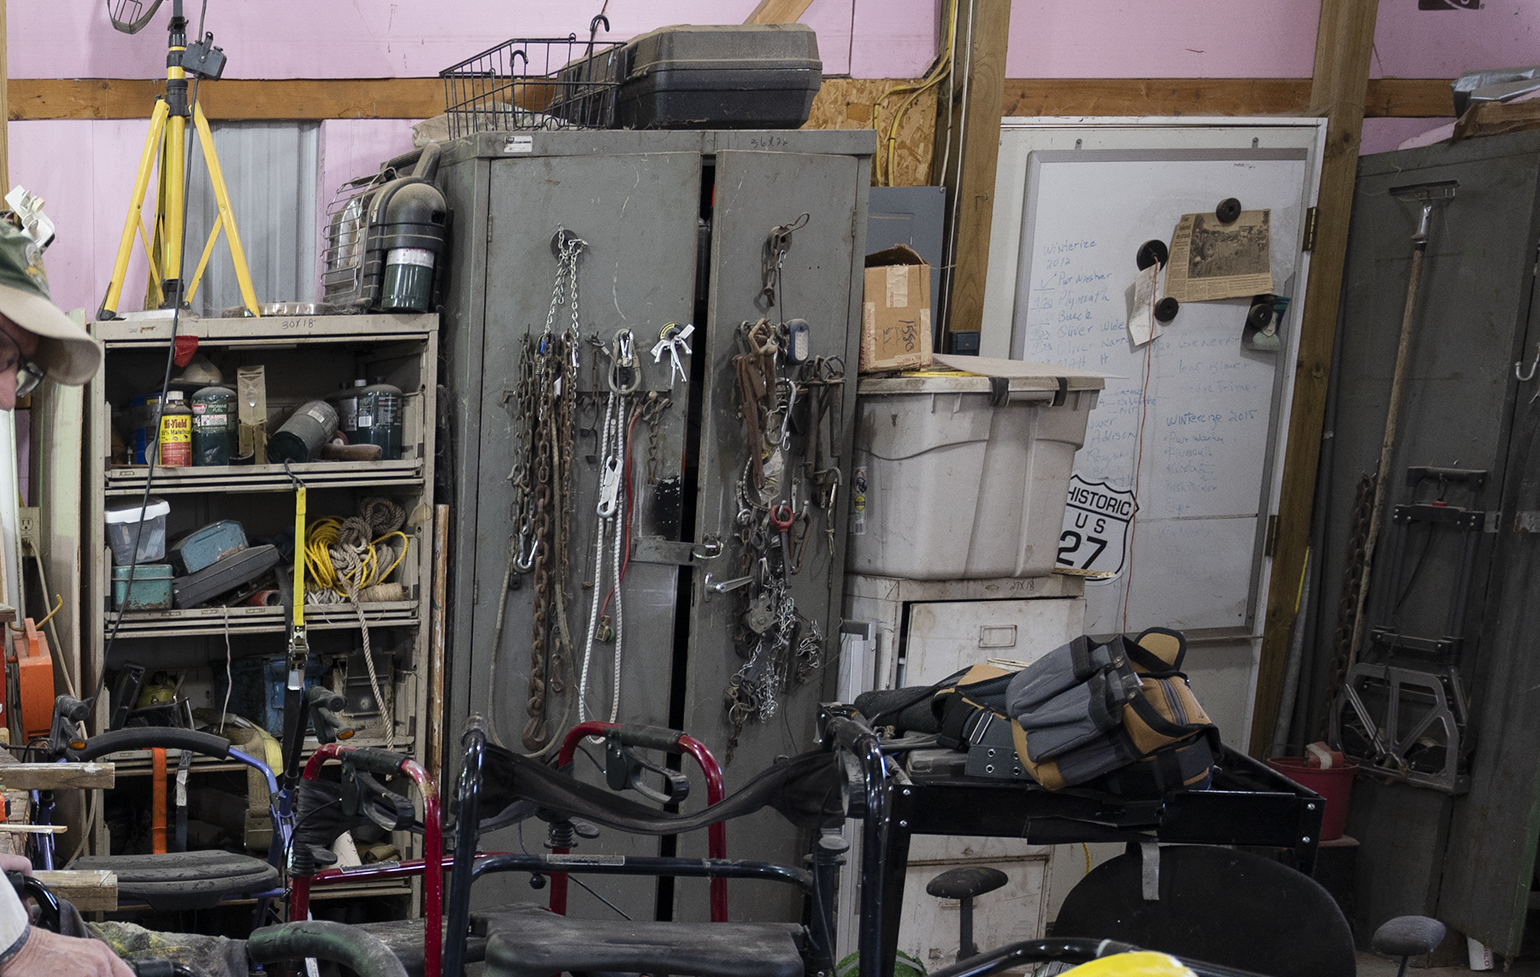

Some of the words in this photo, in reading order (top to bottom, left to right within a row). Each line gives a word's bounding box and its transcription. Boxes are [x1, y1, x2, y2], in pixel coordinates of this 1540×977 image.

[164, 418, 188, 429] Hi-Yield
[1228, 408, 1258, 422] 2015
[1068, 487, 1132, 516] HISTORIC
[1056, 530, 1108, 570] 27
